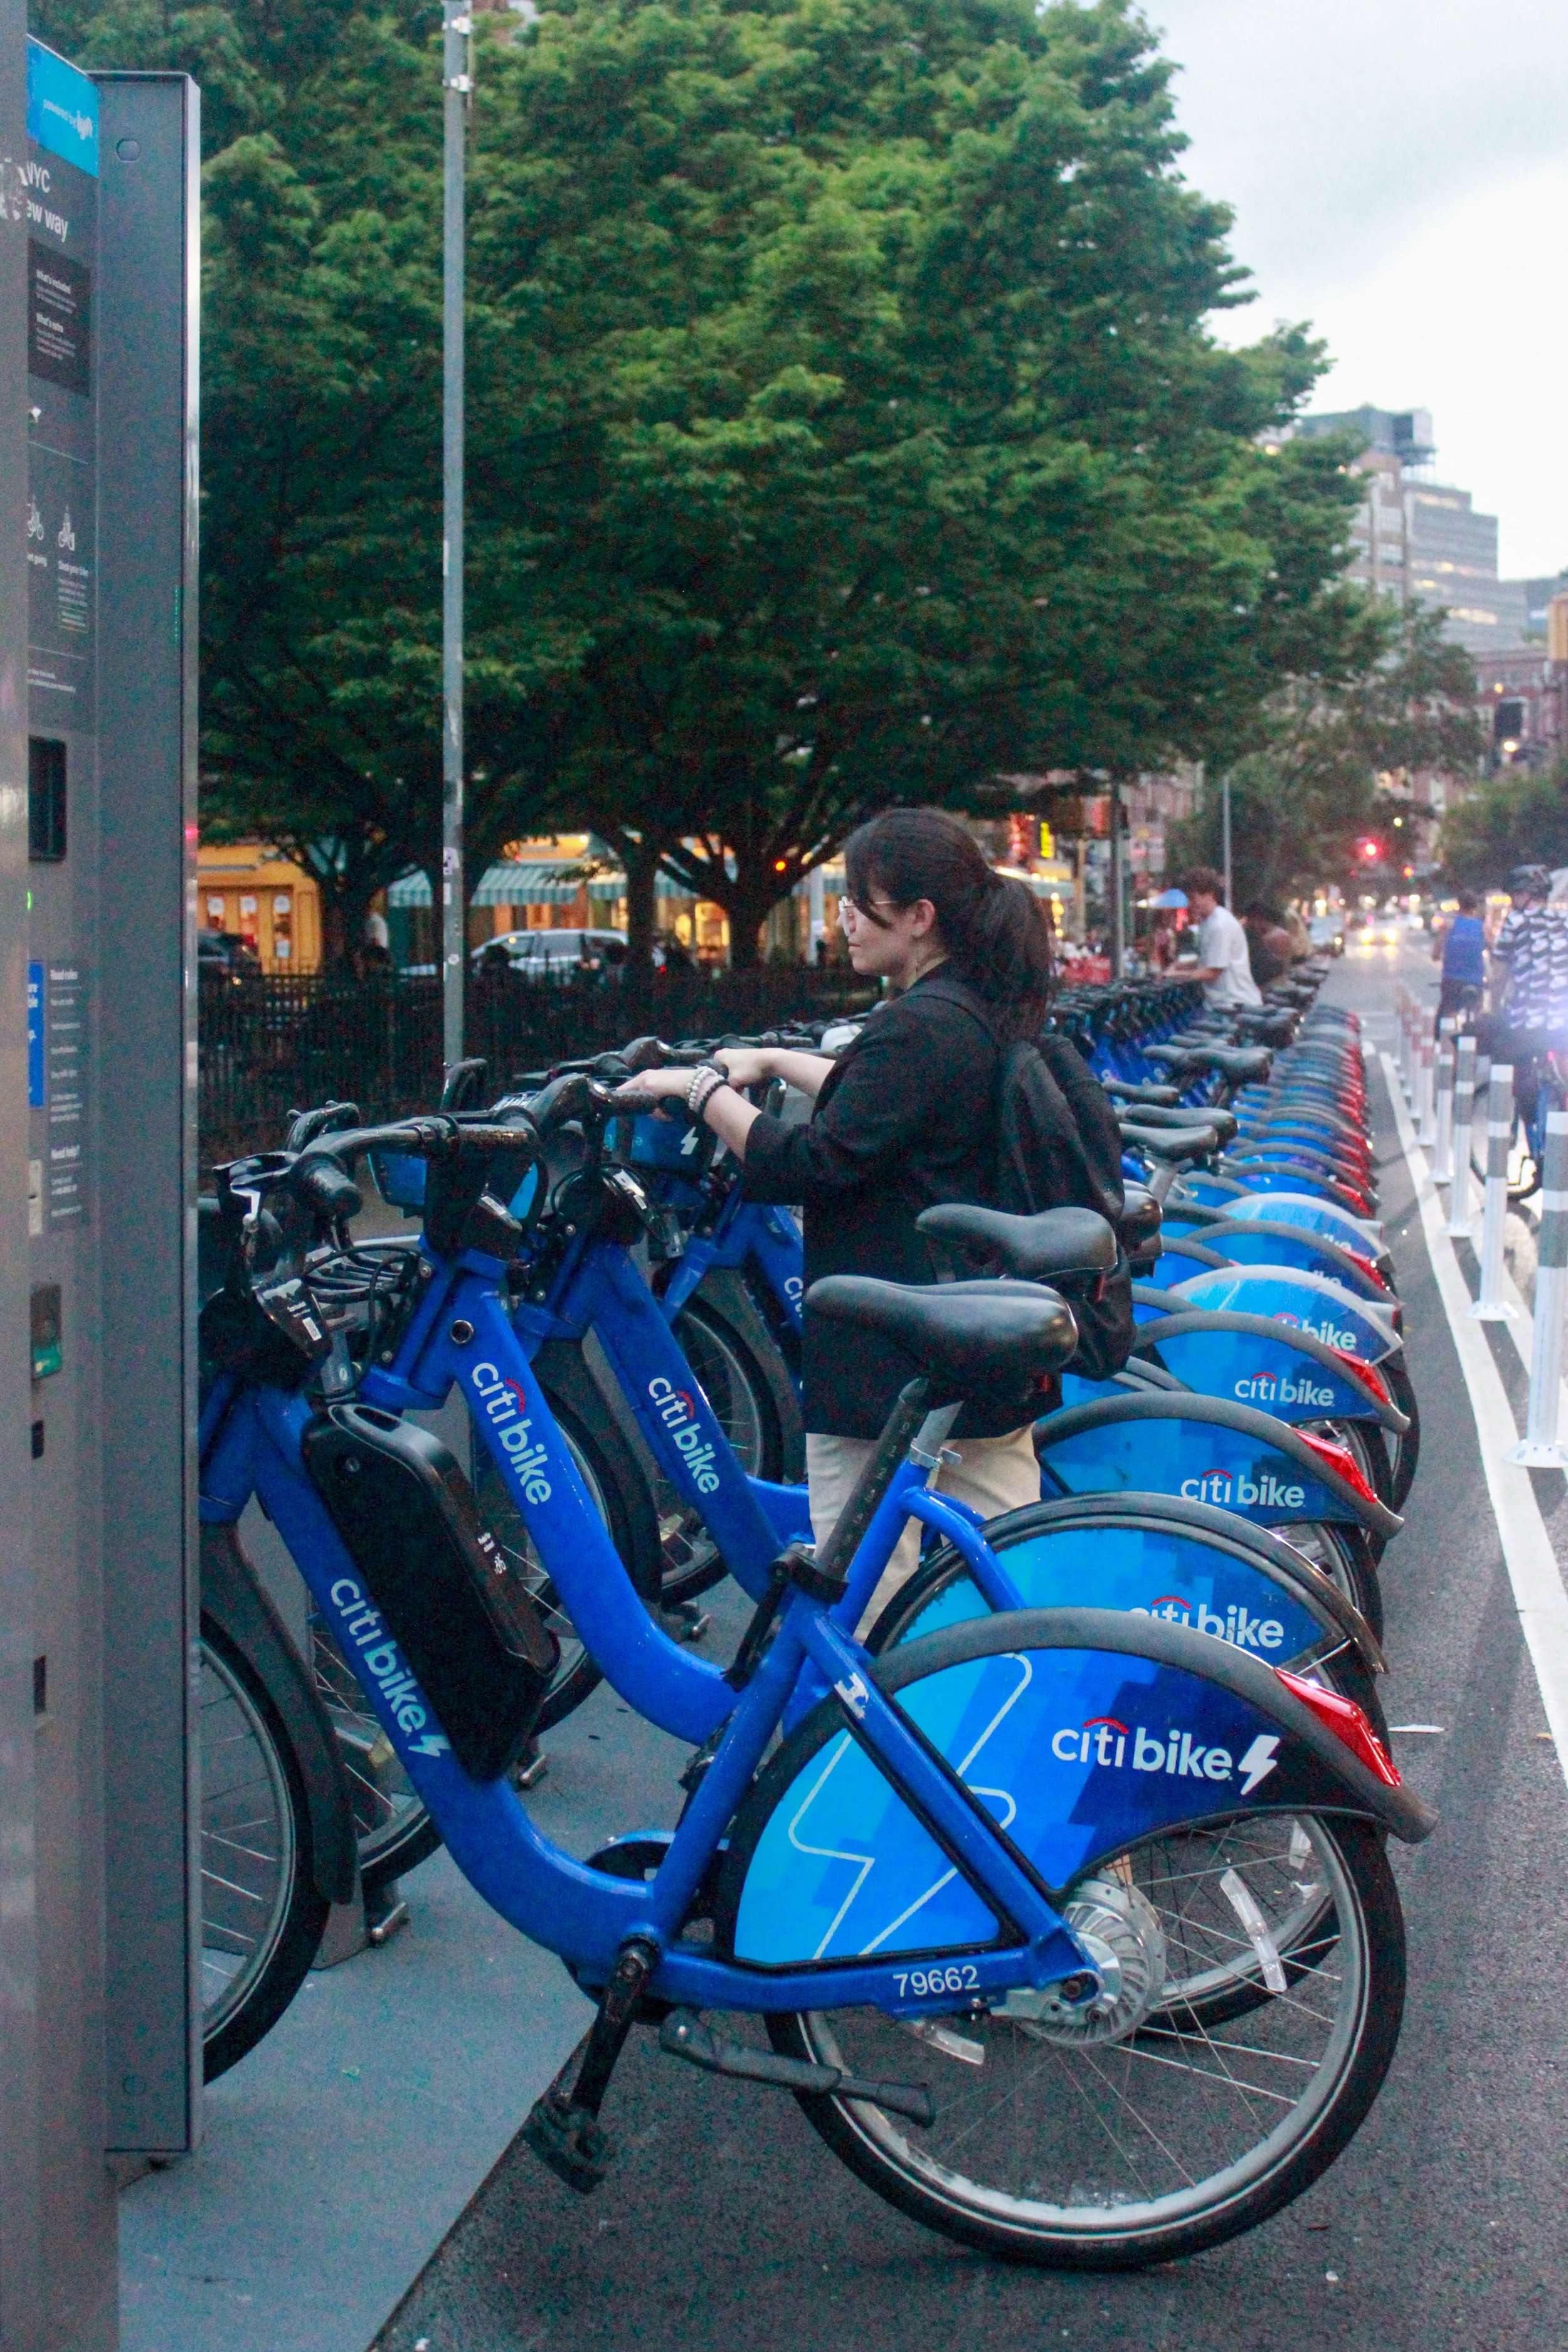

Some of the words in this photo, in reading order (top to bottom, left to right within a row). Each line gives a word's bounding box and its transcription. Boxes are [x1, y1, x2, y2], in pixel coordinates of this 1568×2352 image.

[45, 210, 68, 243] way
[1234, 1375, 1276, 1401] citi
[1279, 1378, 1335, 1407] bike
[472, 1362, 521, 1424] citi
[498, 1419, 552, 1505] bike
[649, 1377, 691, 1428] citi
[672, 1422, 719, 1493] bike
[1180, 1472, 1231, 1503] citi
[1237, 1475, 1305, 1508] bike
[1197, 1604, 1284, 1648] bike
[331, 1579, 383, 1646] citi
[364, 1640, 426, 1733] bike
[1051, 1722, 1126, 1768] citi
[1133, 1726, 1232, 1780] bike
[893, 1965, 980, 1998] 79662
